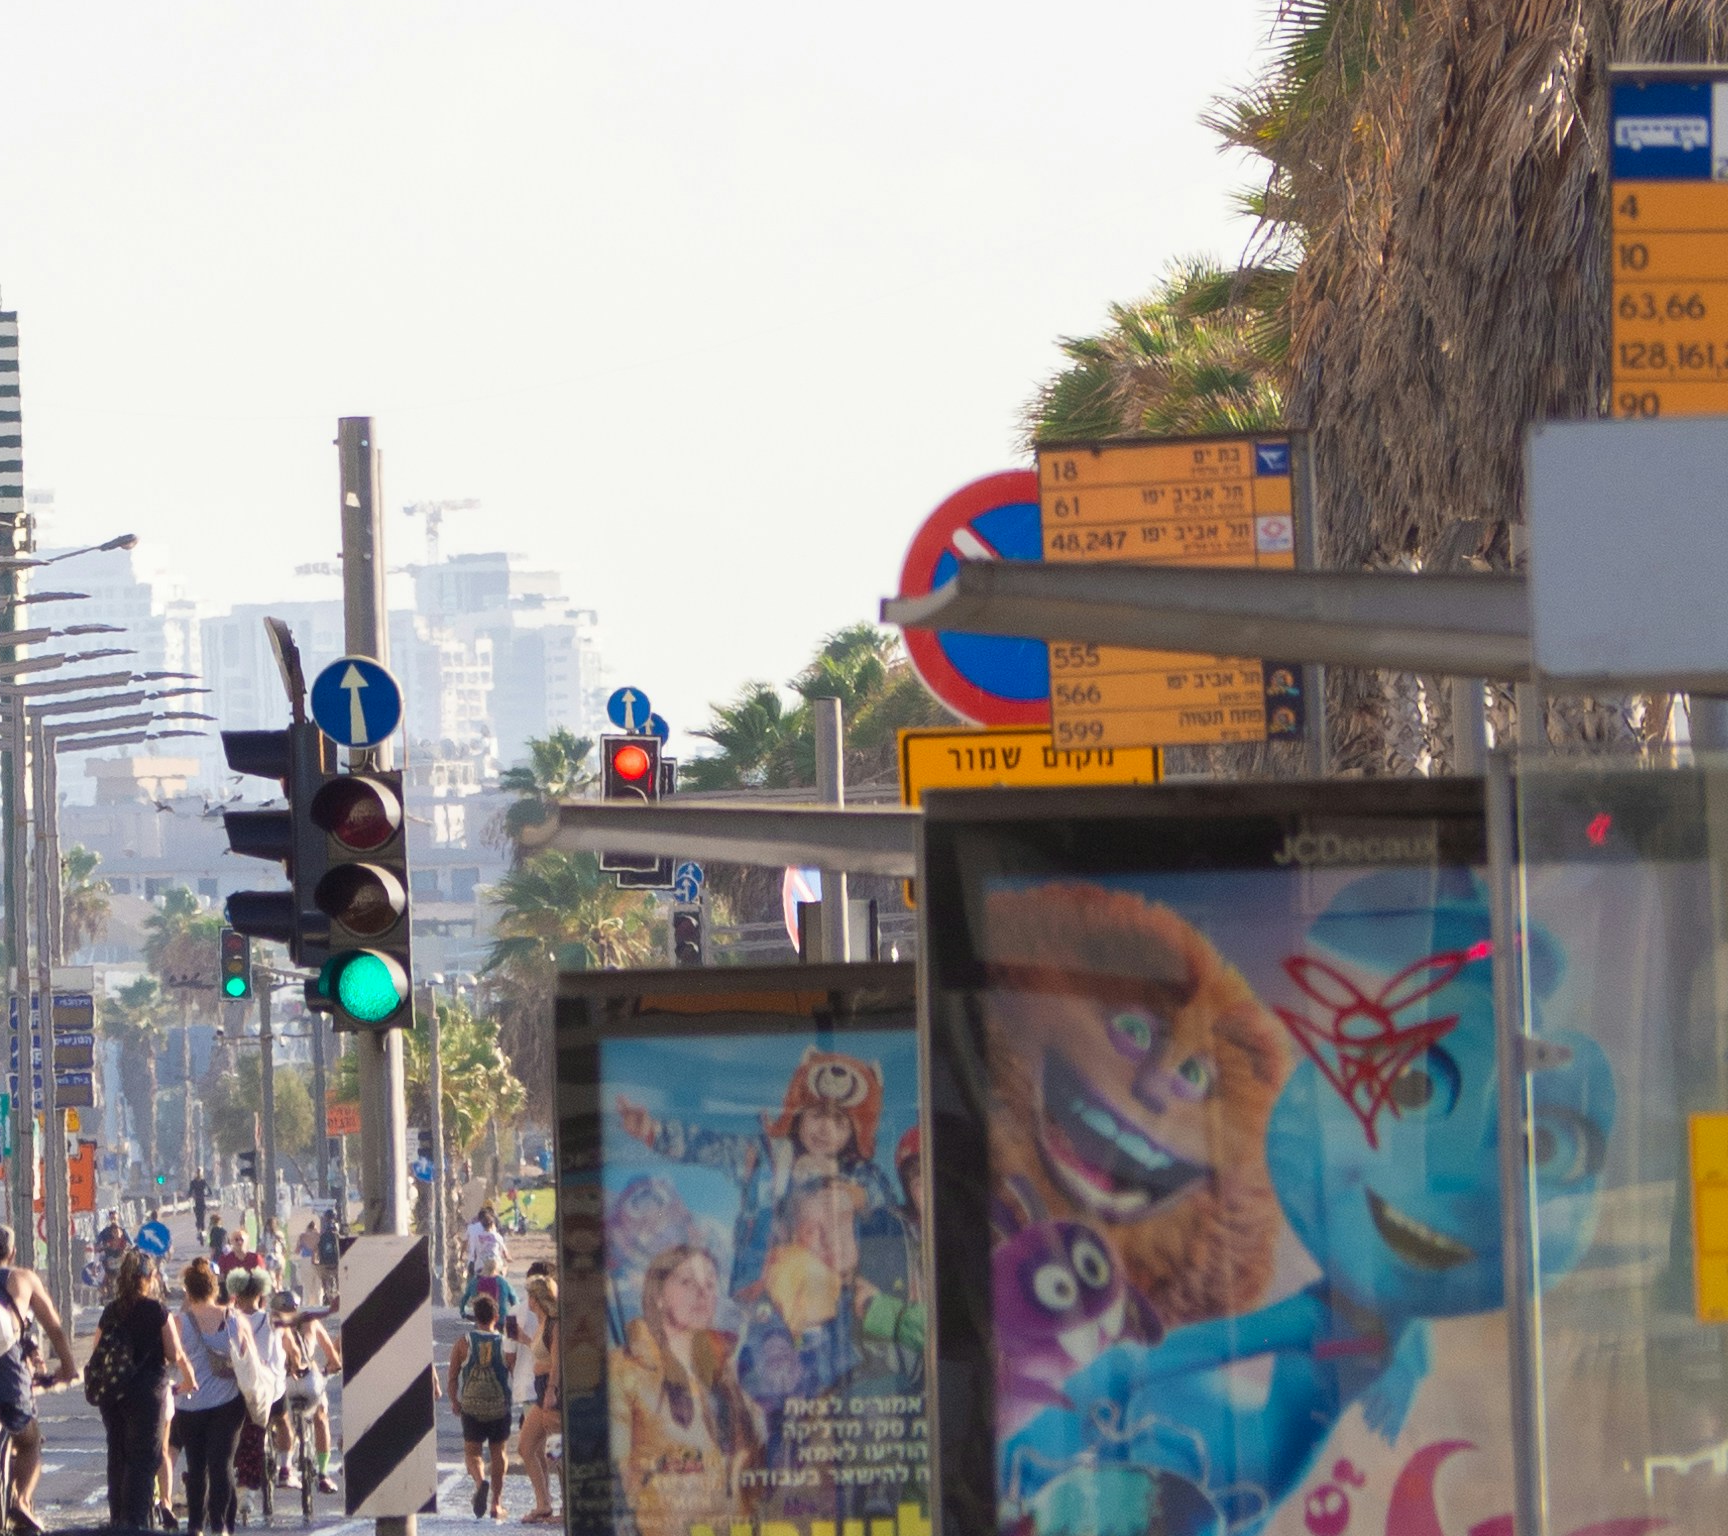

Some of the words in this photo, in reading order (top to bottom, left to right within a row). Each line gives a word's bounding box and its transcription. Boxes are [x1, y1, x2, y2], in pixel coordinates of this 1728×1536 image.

[1618, 194, 1639, 220] 4
[1618, 243, 1649, 271] 10
[1618, 293, 1707, 323] 63,66
[1618, 342, 1728, 375] 128,161,
[1051, 460, 1078, 482] 18
[1054, 496, 1080, 516] 61
[1051, 530, 1127, 555] 48,247
[1054, 645, 1101, 669] 555
[1056, 684, 1102, 706] 566
[1058, 720, 1105, 744] 599
[948, 747, 1022, 771] שמור
